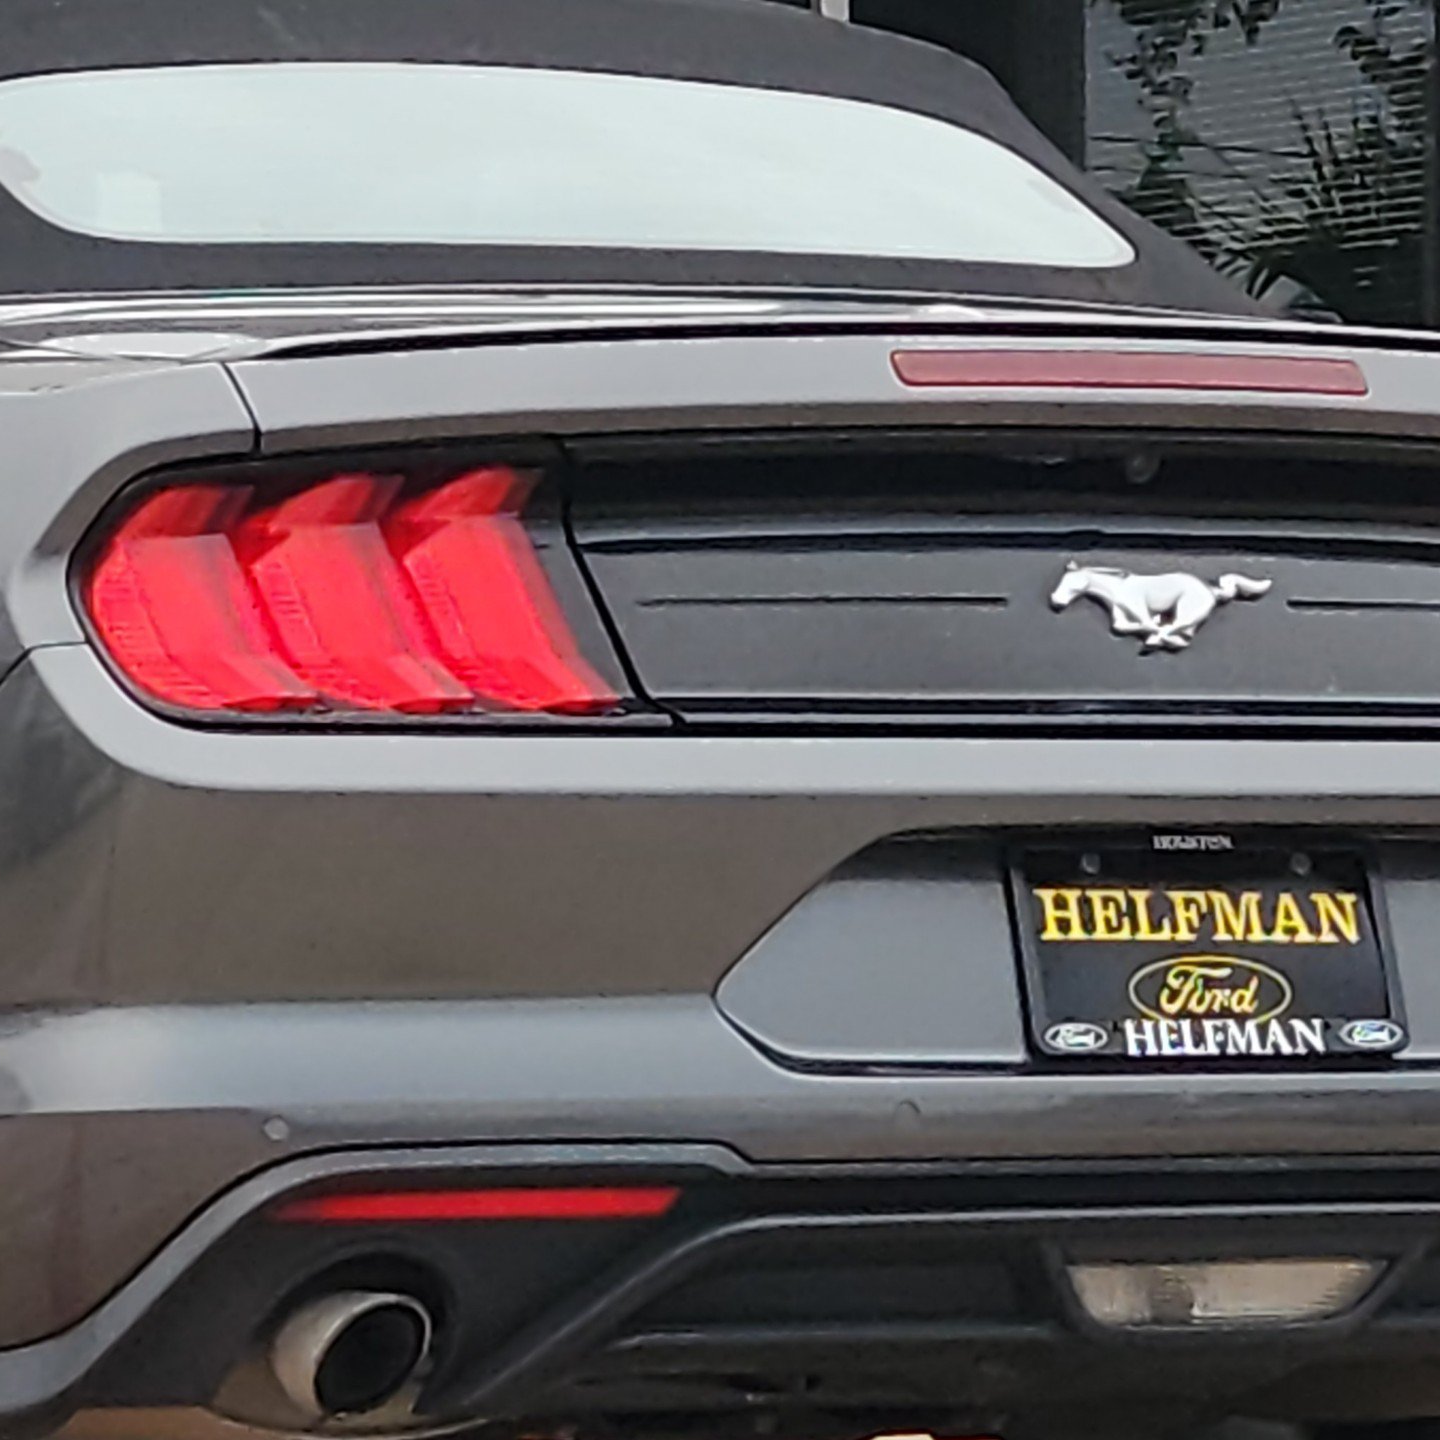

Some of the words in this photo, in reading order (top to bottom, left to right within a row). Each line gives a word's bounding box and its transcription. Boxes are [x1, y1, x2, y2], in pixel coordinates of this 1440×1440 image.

[1032, 887, 1360, 944] HELFMAN
[1159, 965, 1259, 1015] Ford
[1123, 1017, 1327, 1058] HELFMAN
